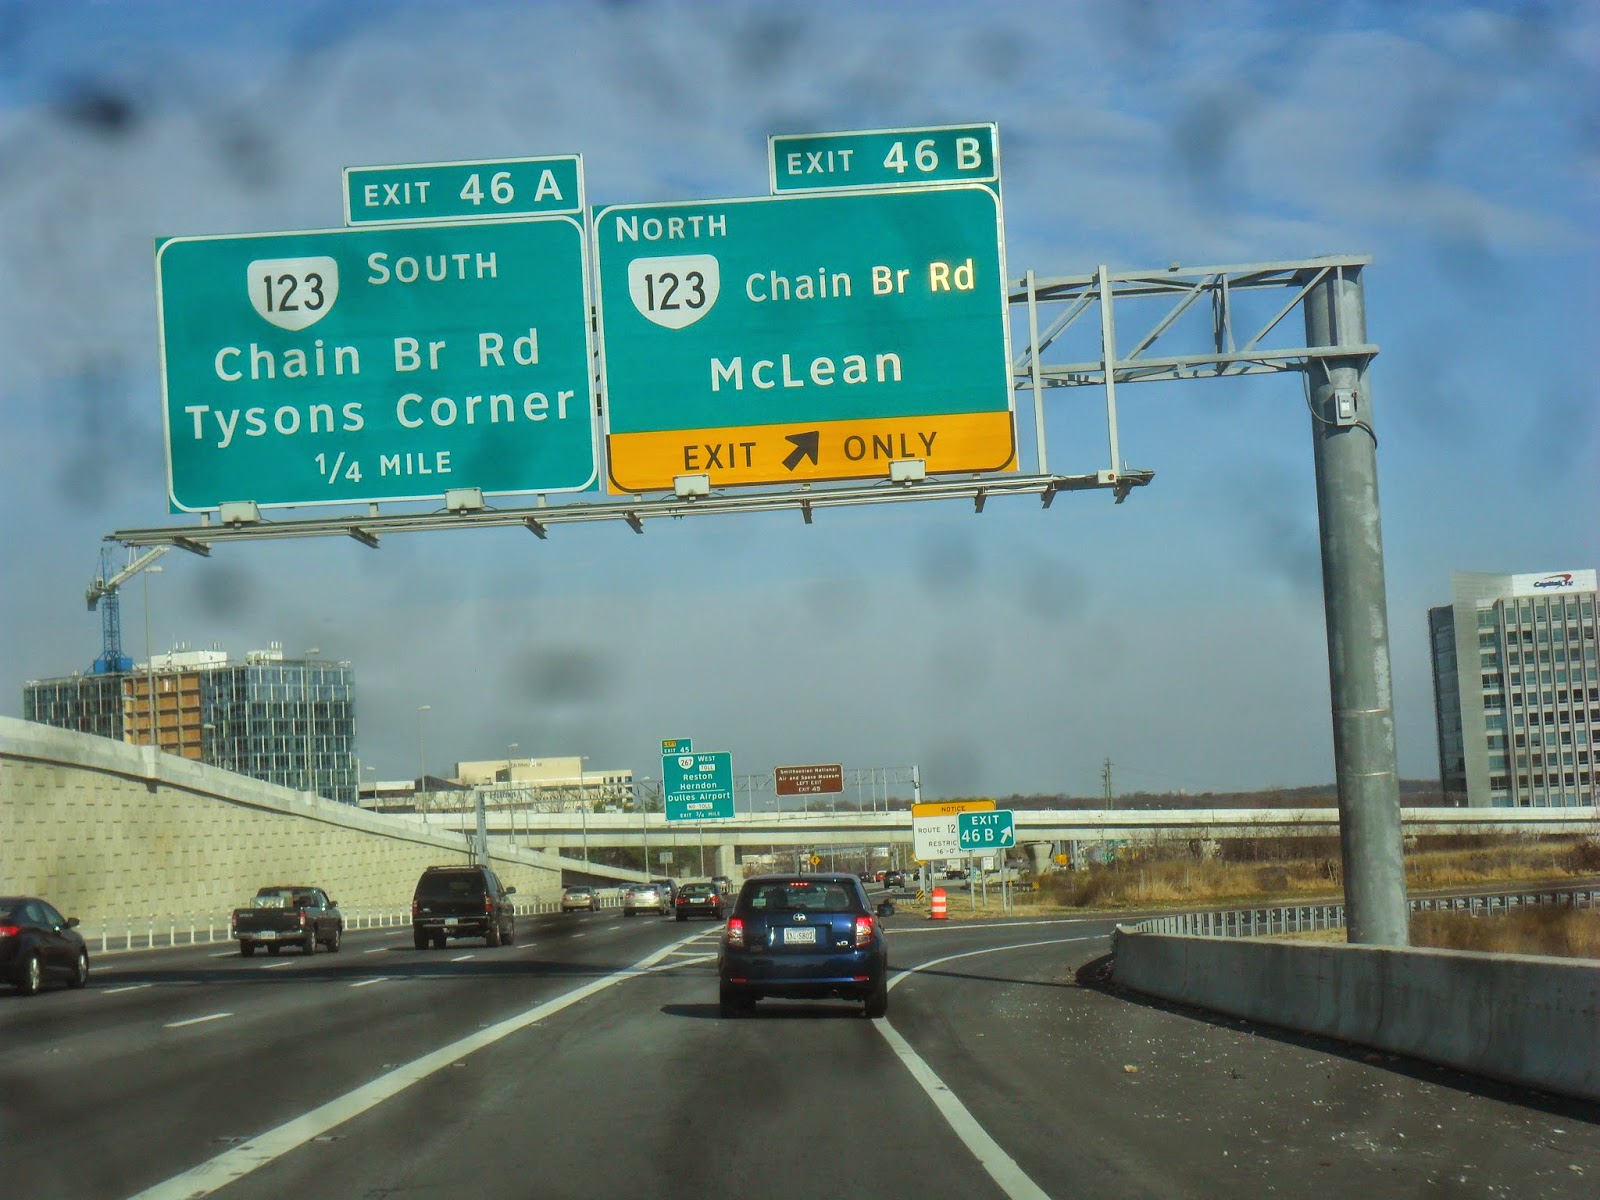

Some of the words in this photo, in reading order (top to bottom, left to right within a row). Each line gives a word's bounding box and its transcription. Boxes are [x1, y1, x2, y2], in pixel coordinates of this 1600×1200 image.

[787, 149, 854, 175] EXIT
[883, 139, 938, 174] 46
[956, 137, 982, 170] B
[364, 181, 430, 207] EXIT
[459, 171, 515, 206] 46
[534, 169, 563, 202] A
[616, 214, 727, 243] NORTH
[367, 251, 498, 285] SOUTH
[745, 267, 851, 302] Chain
[872, 265, 910, 296] Br
[930, 258, 975, 292] Rd
[263, 272, 325, 313] 123
[644, 271, 706, 311] 123
[214, 339, 360, 382] Chain
[394, 336, 446, 372] Br
[478, 328, 539, 368] Rd
[710, 351, 902, 392] McLean
[185, 401, 365, 449] Tysons
[396, 389, 575, 429] Corner
[315, 451, 362, 484] 1/4
[379, 450, 452, 477] MILE
[683, 441, 757, 471] EXIT
[844, 431, 937, 461] ONLY
[681, 759, 692, 767] 267
[683, 773, 713, 781] Reston
[668, 793, 696, 802] Dulles
[700, 792, 731, 801] Airport
[680, 782, 717, 790] Herndon
[947, 824, 956, 834] 12
[961, 829, 981, 843] 46
[985, 828, 994, 842] B
[971, 815, 999, 825] EXIT
